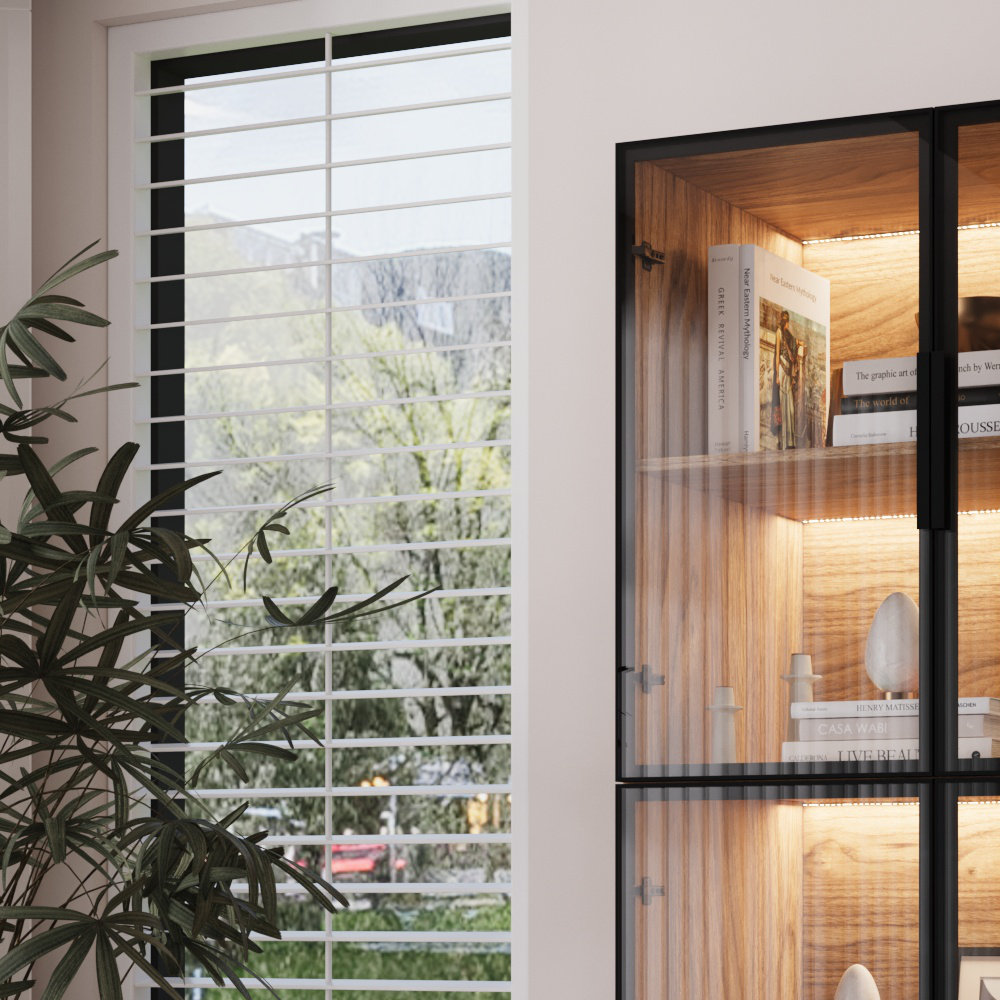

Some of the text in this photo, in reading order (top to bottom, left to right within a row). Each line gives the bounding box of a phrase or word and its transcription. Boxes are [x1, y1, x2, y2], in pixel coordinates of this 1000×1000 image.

[742, 267, 751, 361] Near Eastern Mythology
[855, 371, 869, 380] The
[871, 369, 897, 382] graphic
[898, 369, 908, 377] art
[909, 367, 918, 377] of
[973, 363, 981, 374] by
[855, 395, 911, 409] The world of
[856, 702, 919, 712] HENRY MATISSE
[817, 721, 888, 736] CASA WABI
